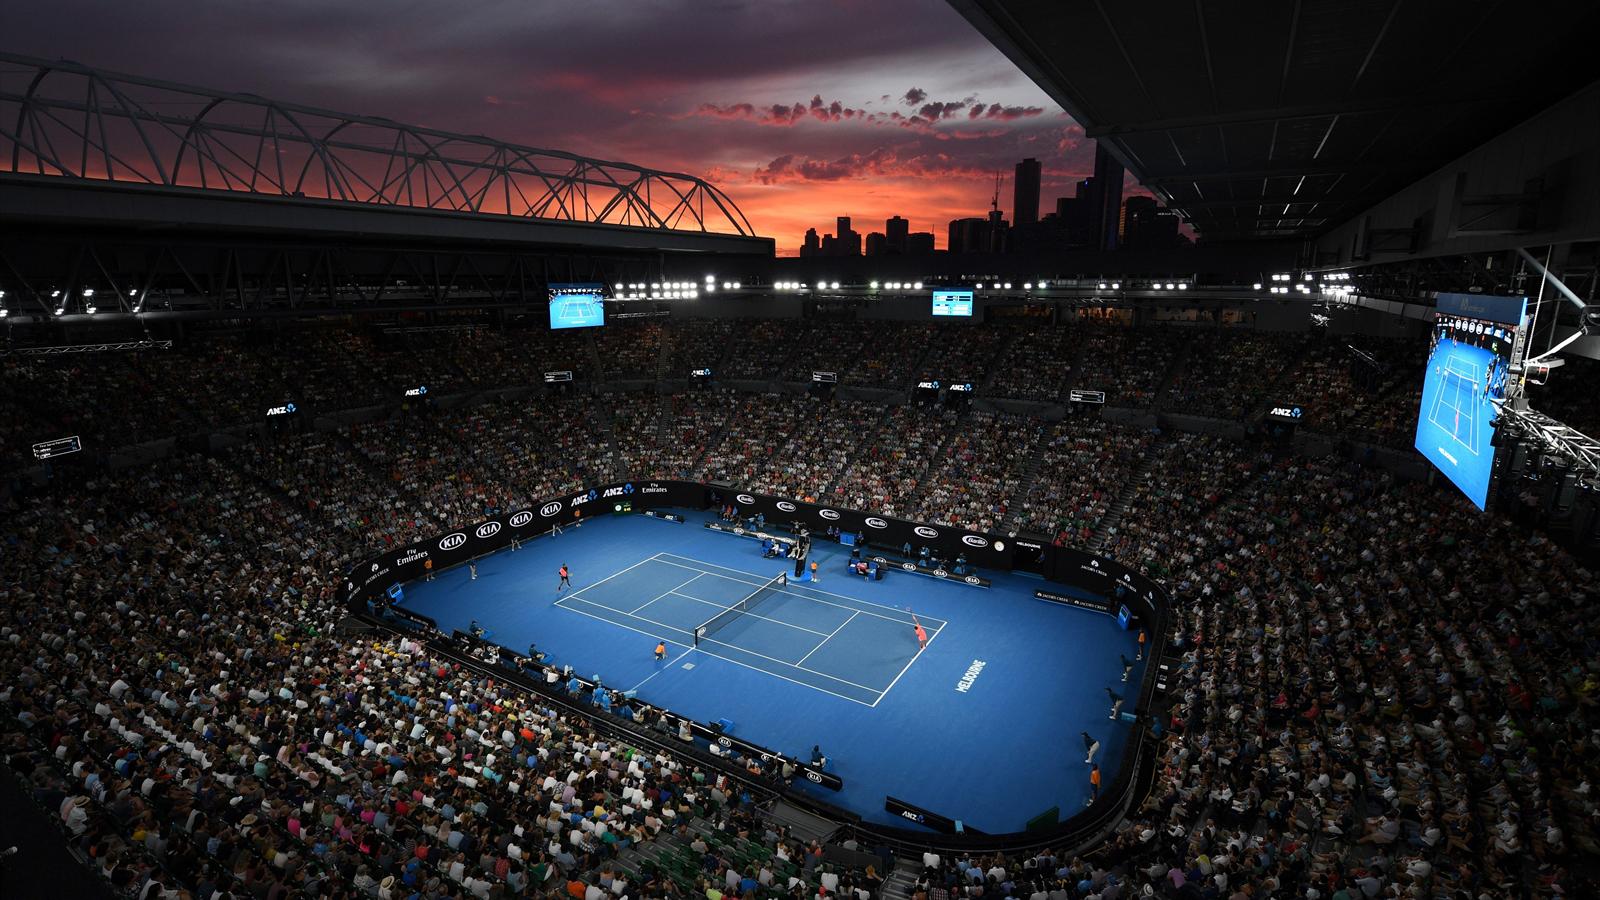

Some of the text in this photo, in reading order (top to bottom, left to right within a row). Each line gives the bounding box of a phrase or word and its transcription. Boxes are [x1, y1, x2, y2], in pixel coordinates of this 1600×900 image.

[918, 381, 932, 389] ANZ
[405, 388, 420, 396] ANZ
[266, 406, 287, 416] ANZ
[1270, 407, 1292, 417] ANZ
[602, 487, 623, 498] ANZ
[571, 494, 589, 507] ANZ
[543, 502, 560, 515] KIA
[512, 512, 530, 525] KIA
[479, 523, 499, 536] KIA
[443, 535, 464, 549] KIA
[396, 550, 428, 566] Emirates
[955, 659, 987, 693] MELBOURNE
[901, 810, 917, 821] ANZ
